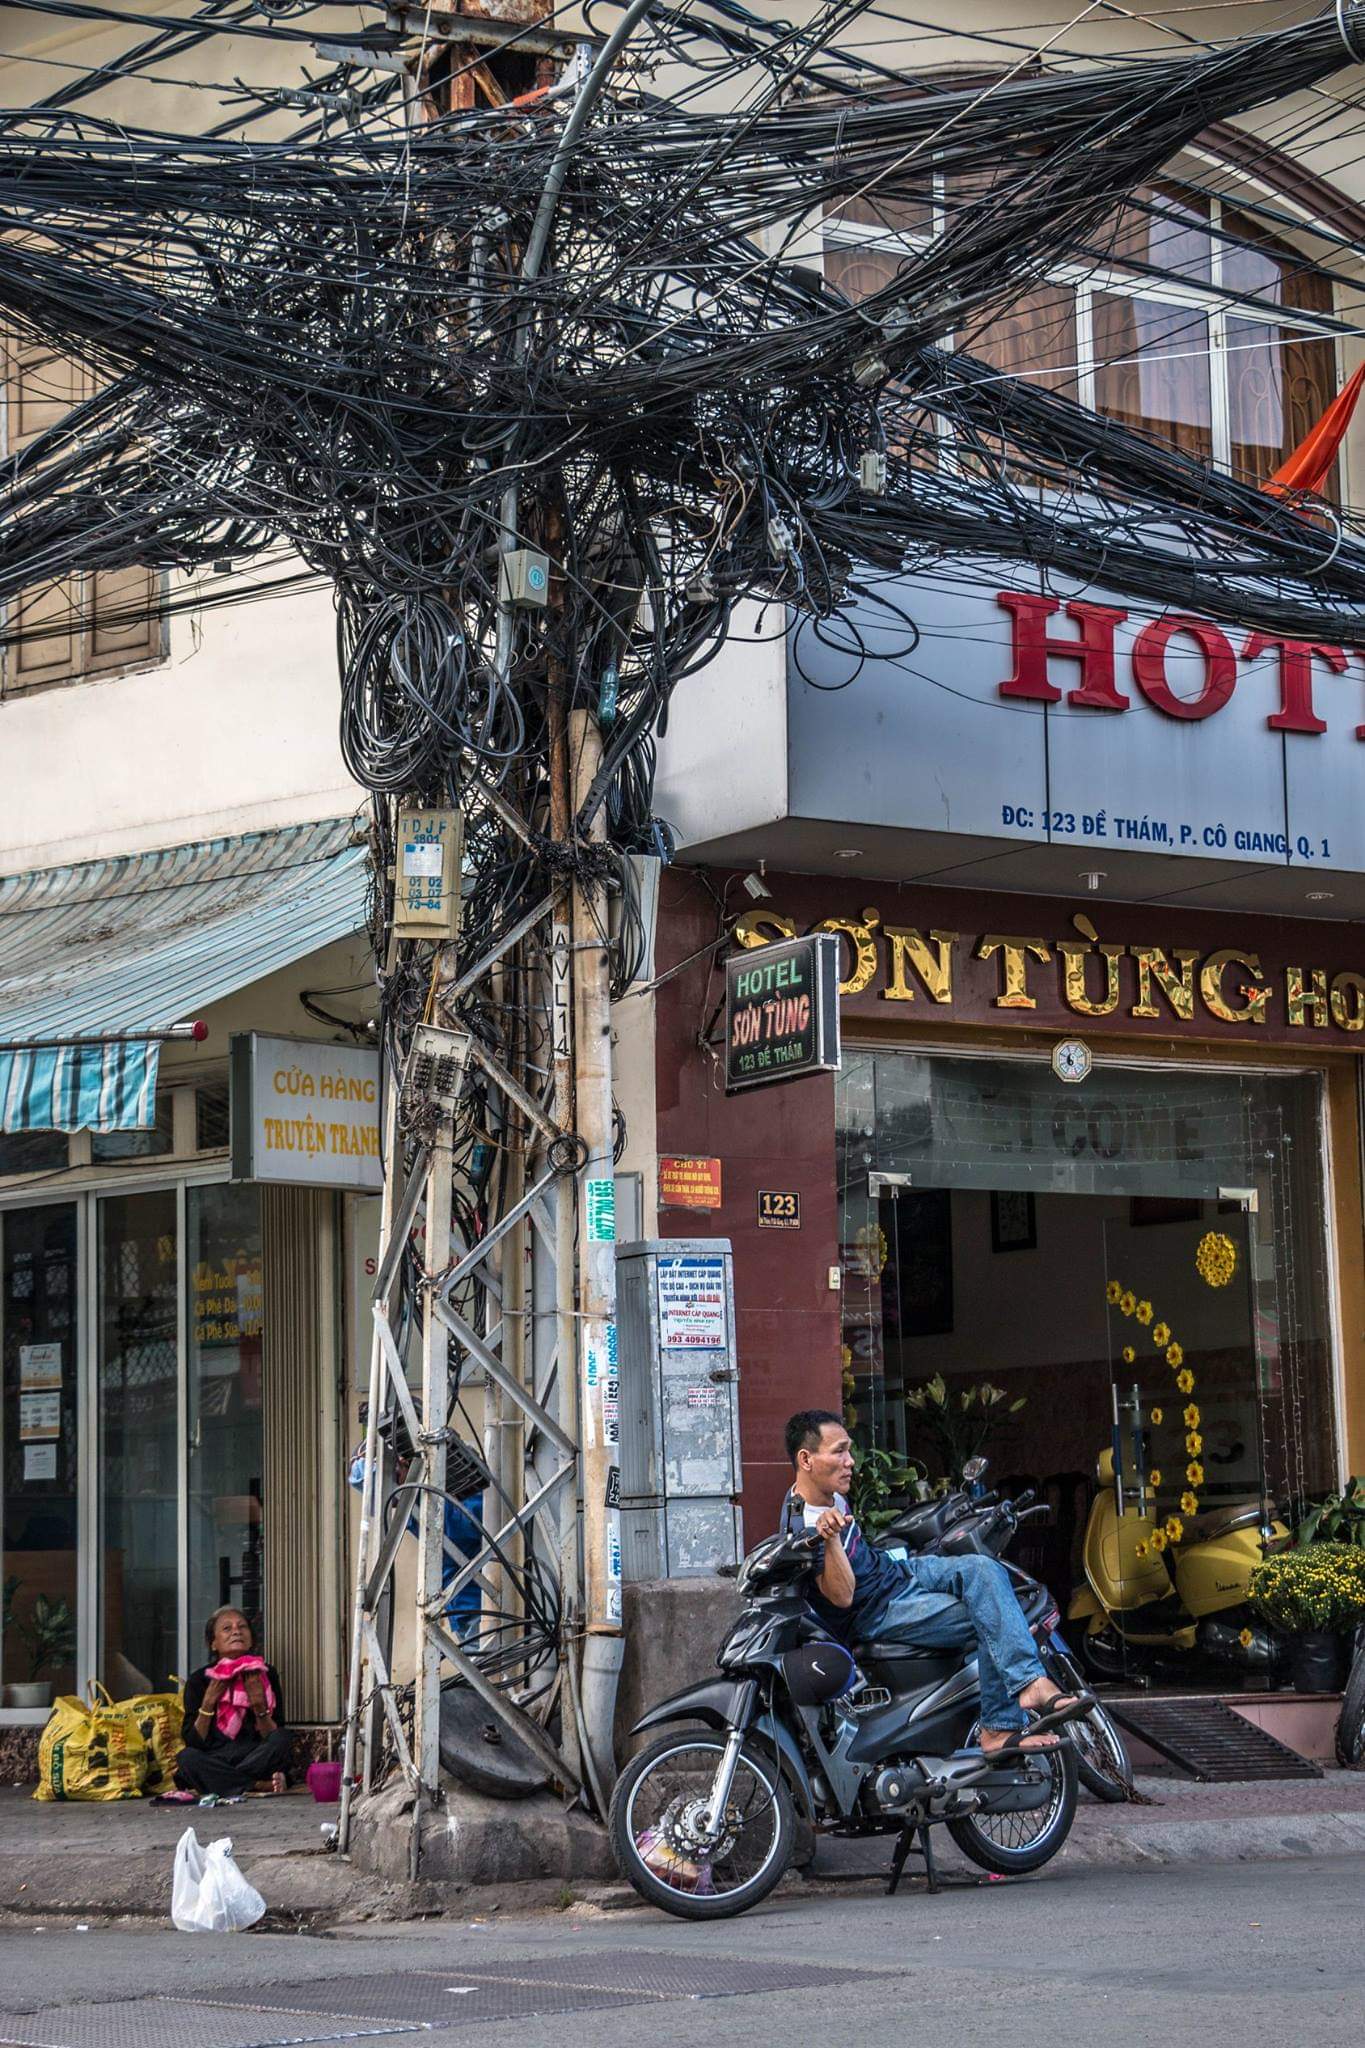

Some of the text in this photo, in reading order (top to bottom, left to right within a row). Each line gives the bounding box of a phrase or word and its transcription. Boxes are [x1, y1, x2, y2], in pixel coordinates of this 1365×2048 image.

[997, 591, 1365, 741] HOT
[1002, 805, 1330, 859] ĐC: 123 ĐỀ THÁM, P. CÔ GIANG, Q. 1
[428, 877, 442, 887] 02
[737, 957, 802, 998] HOTEL
[977, 913, 1272, 1023] TÙNG
[732, 990, 810, 1047] SƠN TÙNG
[739, 1054, 755, 1072] 123
[774, 1040, 803, 1063] THÁM
[273, 1064, 376, 1103] CỬA HÀNG
[264, 1112, 326, 1159] TRUYỆN
[595, 1181, 615, 1240] 0977 700 955
[763, 1194, 795, 1216] 123
[668, 1308, 691, 1317] INTERNET
[703, 1310, 720, 1319] QUANG
[668, 1335, 682, 1344] 093
